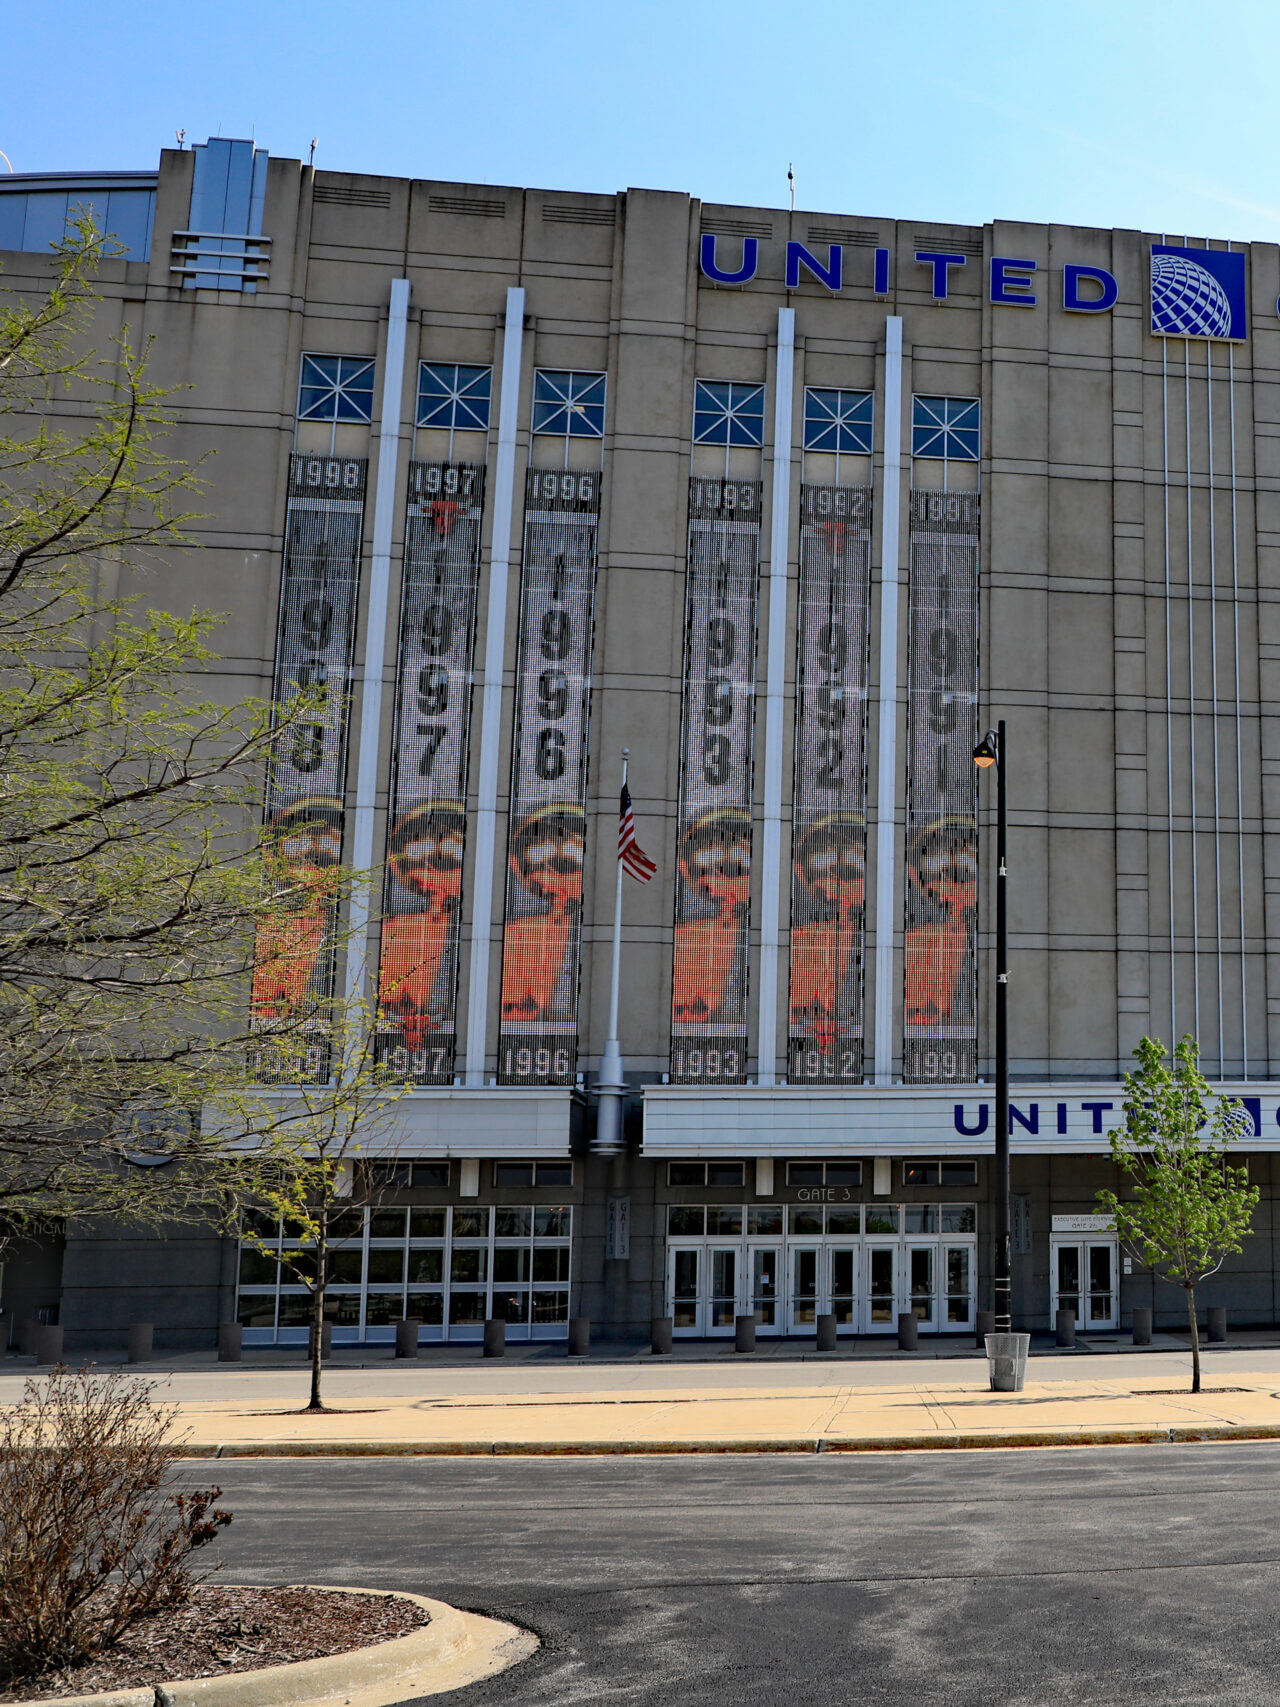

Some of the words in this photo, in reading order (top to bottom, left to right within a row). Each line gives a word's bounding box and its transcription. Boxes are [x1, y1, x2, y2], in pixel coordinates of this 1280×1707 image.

[700, 234, 1119, 314] UNITED
[295, 461, 360, 489] 1998
[416, 467, 477, 495] 1997
[533, 474, 594, 501] 1996
[695, 482, 754, 511] 1993
[808, 489, 865, 517] 1992
[919, 496, 971, 522] 1991
[416, 547, 453, 777] 1997
[535, 553, 571, 781] 1996
[702, 561, 735, 786] 1993
[816, 567, 847, 790] 1992
[928, 573, 958, 793] 1991
[506, 1049, 570, 1076] 1996
[676, 1049, 739, 1077] 1993
[796, 1050, 855, 1078] 1992
[914, 1051, 968, 1079] 1991
[953, 1102, 1208, 1136] UNIT
[797, 1188, 836, 1201] GATE
[841, 1188, 851, 1201] 3
